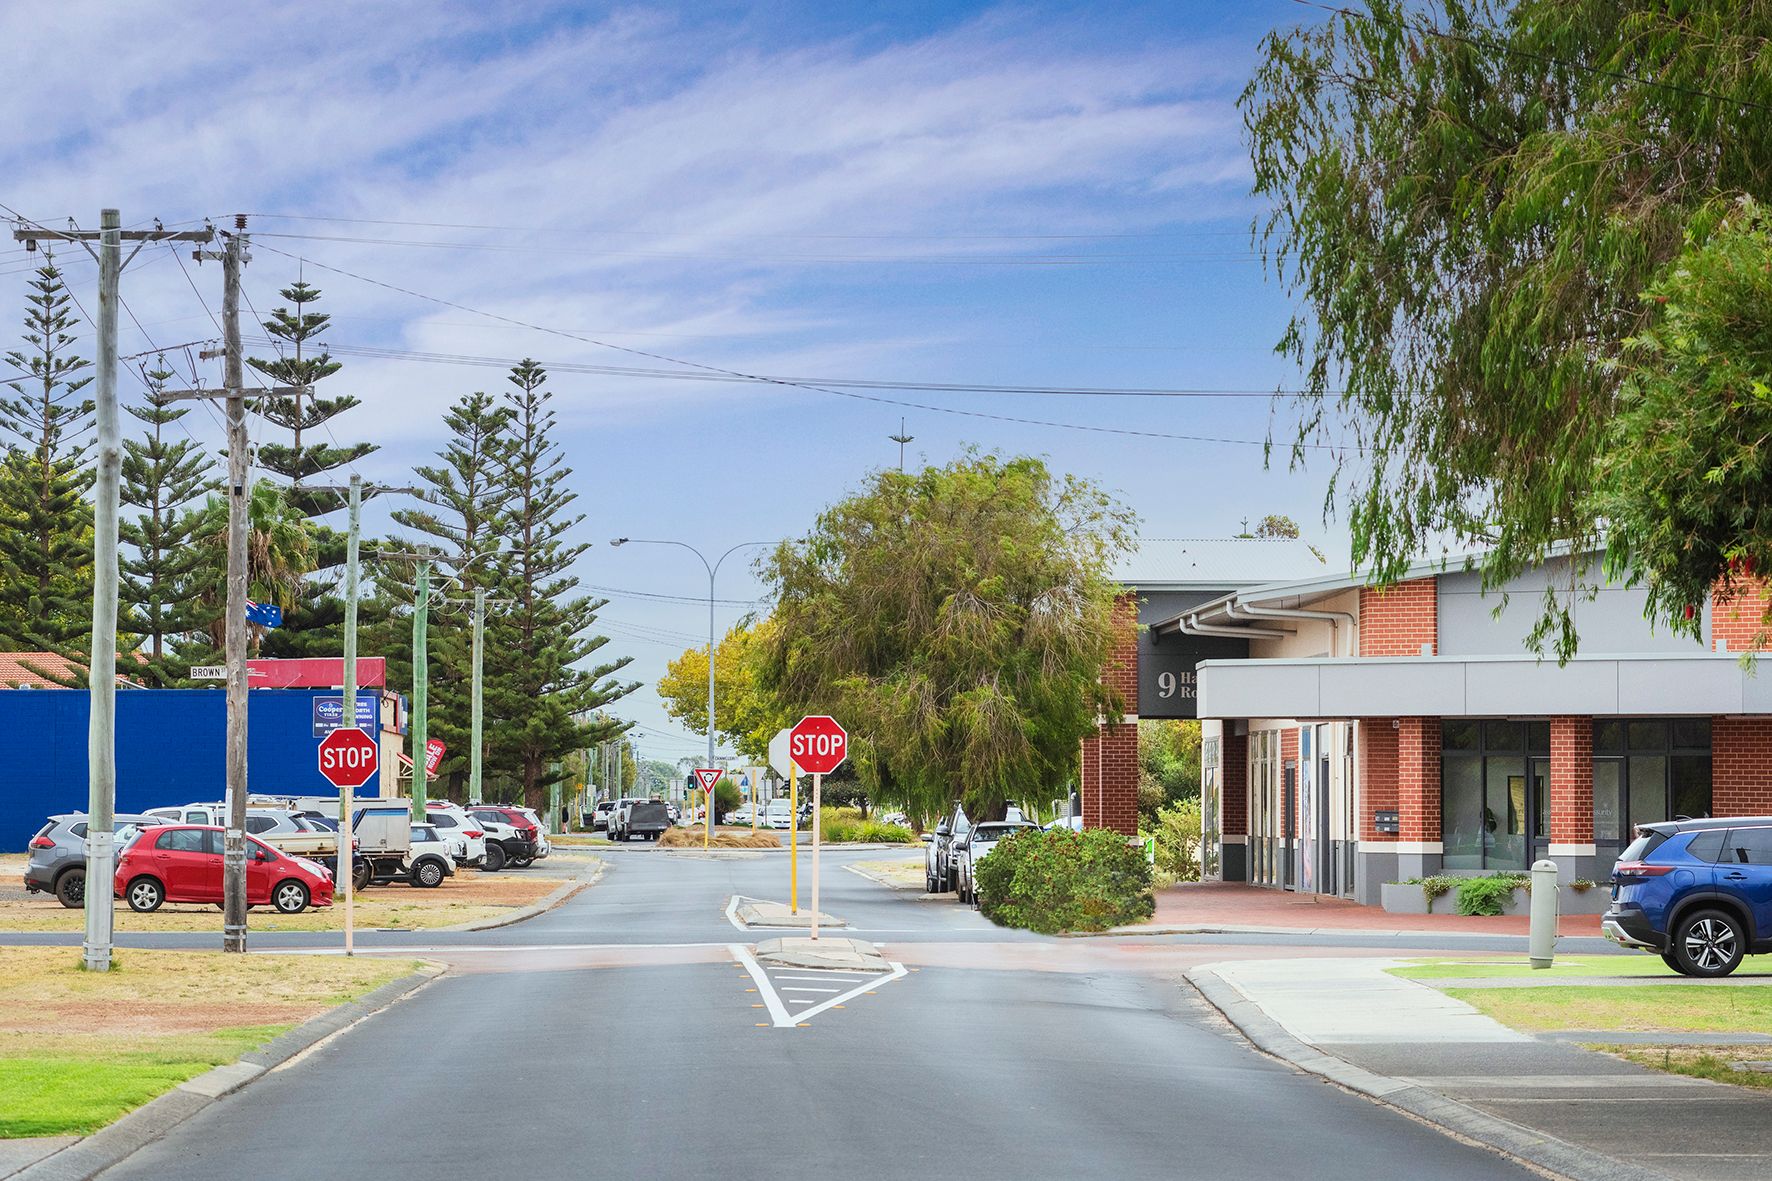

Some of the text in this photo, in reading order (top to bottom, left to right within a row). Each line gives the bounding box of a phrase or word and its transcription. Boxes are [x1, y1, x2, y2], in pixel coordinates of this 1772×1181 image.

[192, 668, 220, 677] BROWN
[1181, 671, 1197, 684] Ha
[1158, 671, 1176, 699] 9
[1181, 686, 1197, 699] Ro
[318, 705, 343, 713] Cooper
[792, 734, 843, 756] STOP
[323, 747, 373, 769] STOP
